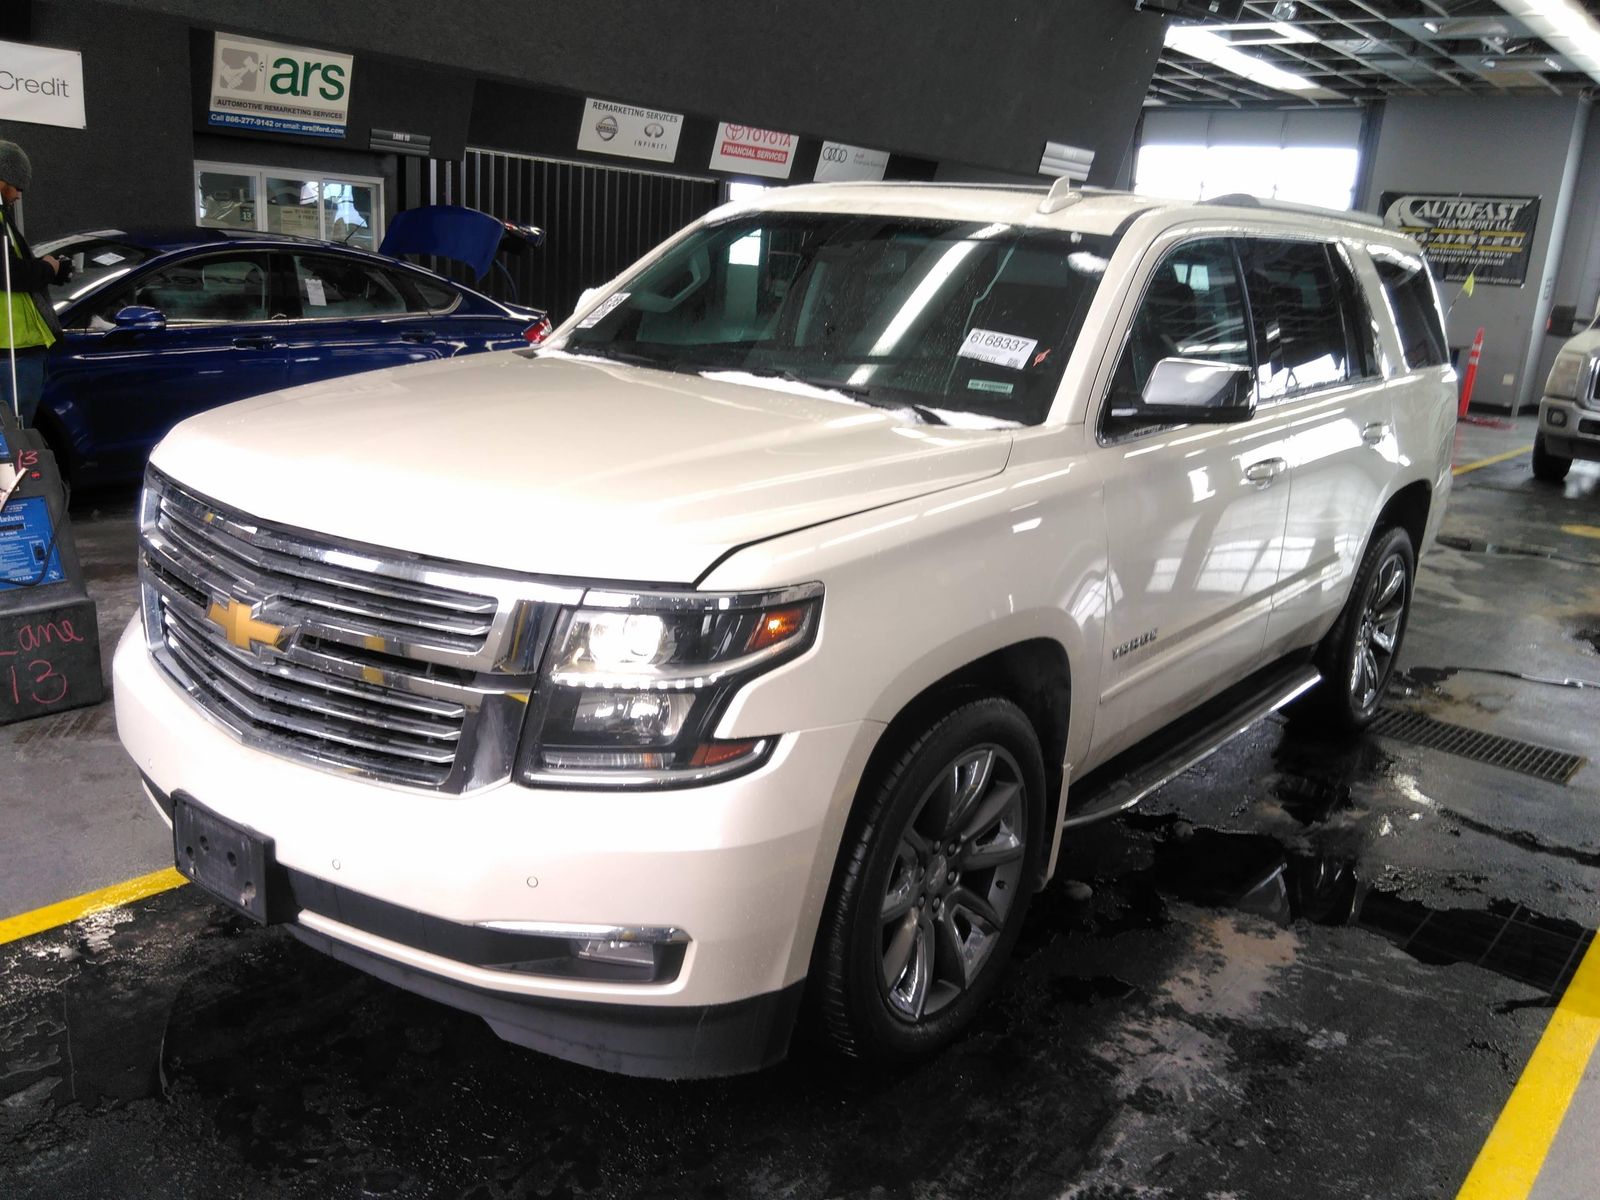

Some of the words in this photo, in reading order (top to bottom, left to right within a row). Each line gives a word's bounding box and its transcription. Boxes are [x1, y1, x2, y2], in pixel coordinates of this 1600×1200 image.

[0, 70, 69, 98] Credit
[269, 57, 345, 101] ars
[211, 113, 225, 121] Call
[216, 99, 263, 111] AUTOMOTIVE
[264, 104, 312, 116] REMARKETING
[313, 110, 343, 119] SERVICES
[592, 101, 645, 118] REMARKETING
[645, 111, 678, 123] SERVICES
[634, 140, 668, 150] INFINITI
[746, 126, 791, 148] TOYOTA
[722, 144, 756, 159] FINANCIAL
[756, 151, 786, 164] SERVICES
[1414, 200, 1521, 220] AUTOFAST
[1437, 218, 1494, 230] TRANSPORT
[1496, 220, 1514, 231] LLC
[970, 332, 1029, 352] 6168337
[11, 660, 67, 704] 13
